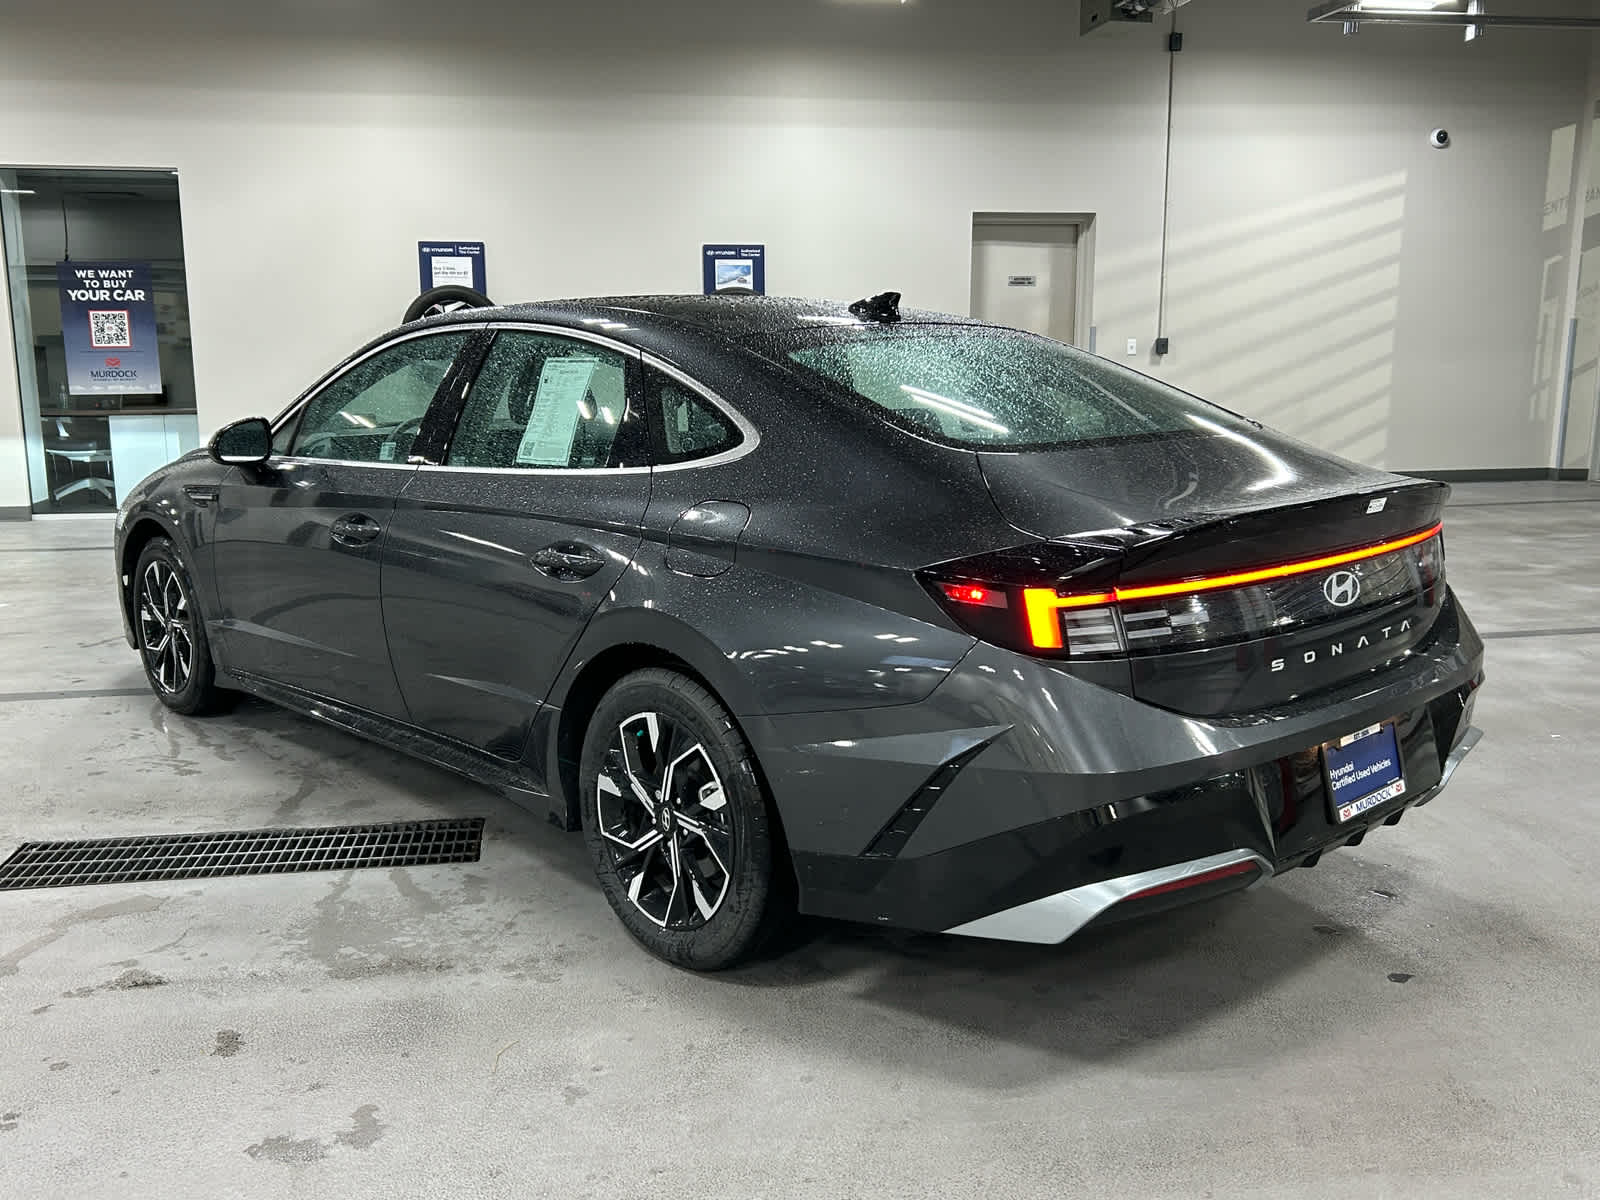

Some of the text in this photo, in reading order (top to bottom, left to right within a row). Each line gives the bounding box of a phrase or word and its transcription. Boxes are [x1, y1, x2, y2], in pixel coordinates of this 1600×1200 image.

[75, 270, 133, 278] WE WANT
[83, 280, 127, 288] TO BUY
[67, 289, 145, 301] YOUR CAR
[90, 370, 137, 378] MURDOCK
[1271, 620, 1411, 672] SONATA
[1329, 761, 1355, 780] Hyundai
[1331, 758, 1392, 791] Certified Used Vehicles
[1355, 787, 1392, 813] MURDOCK
